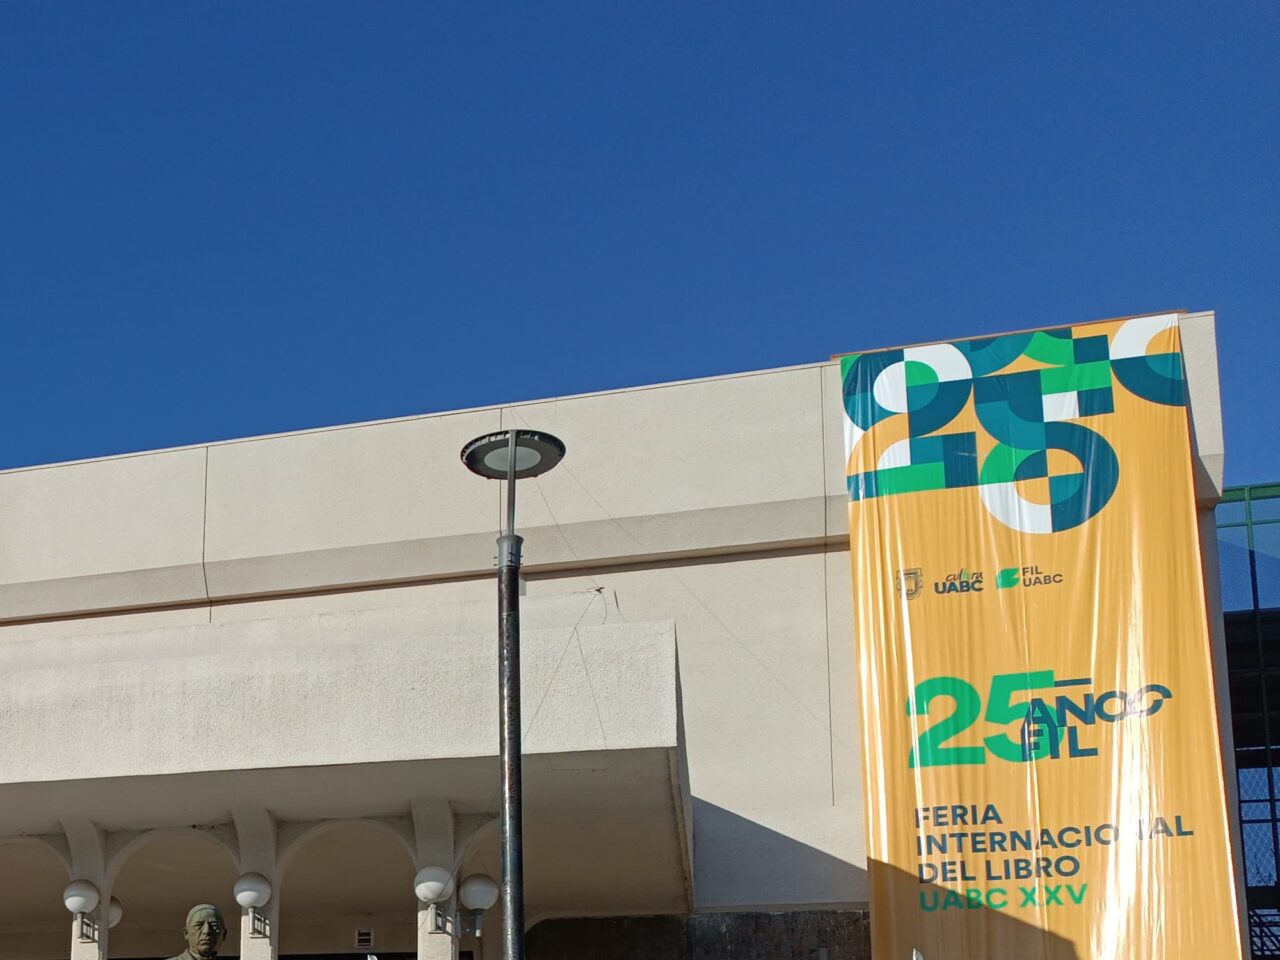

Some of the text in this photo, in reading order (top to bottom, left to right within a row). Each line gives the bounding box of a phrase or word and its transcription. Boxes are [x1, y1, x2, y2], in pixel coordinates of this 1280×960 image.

[1022, 566, 1043, 577] FIL
[1023, 573, 1063, 588] UABC
[934, 580, 984, 594] UABC
[906, 670, 1065, 768] 25
[914, 803, 1003, 829] FERIA
[919, 855, 1080, 884] DEL LIBRO
[919, 883, 1088, 912] UABC XXV
